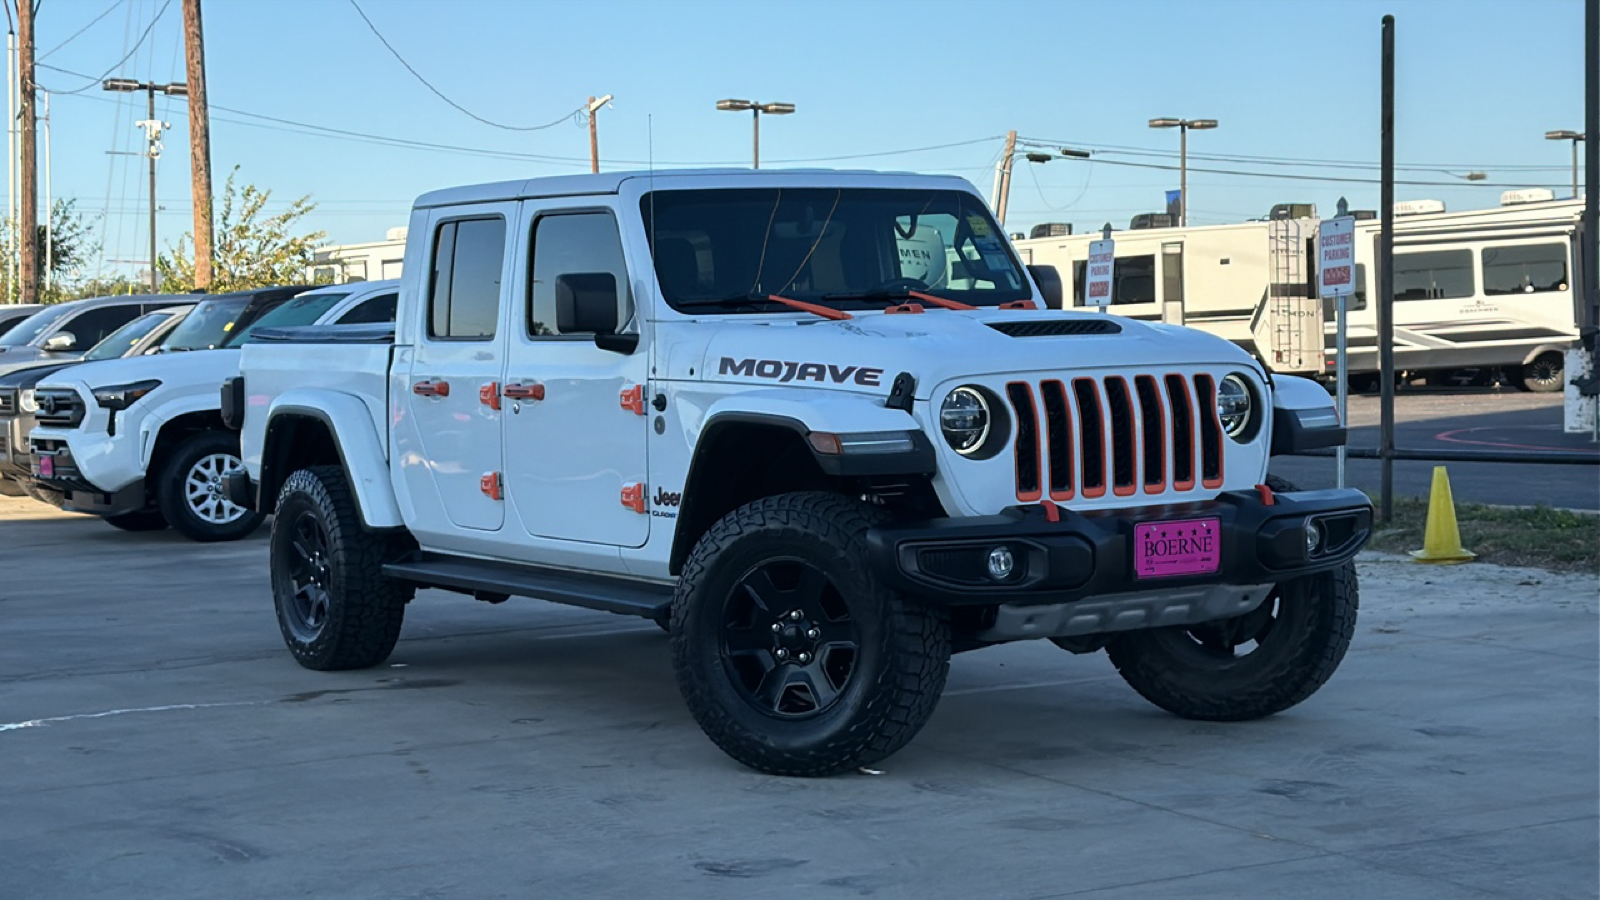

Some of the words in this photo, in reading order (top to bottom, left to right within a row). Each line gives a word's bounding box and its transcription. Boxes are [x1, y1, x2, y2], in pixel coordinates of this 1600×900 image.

[1321, 232, 1352, 247] CUSTOMER
[900, 249, 931, 260] MEN
[1324, 247, 1350, 260] PARKING
[718, 356, 885, 387] MOJAVE
[1145, 536, 1213, 557] BOERNE
